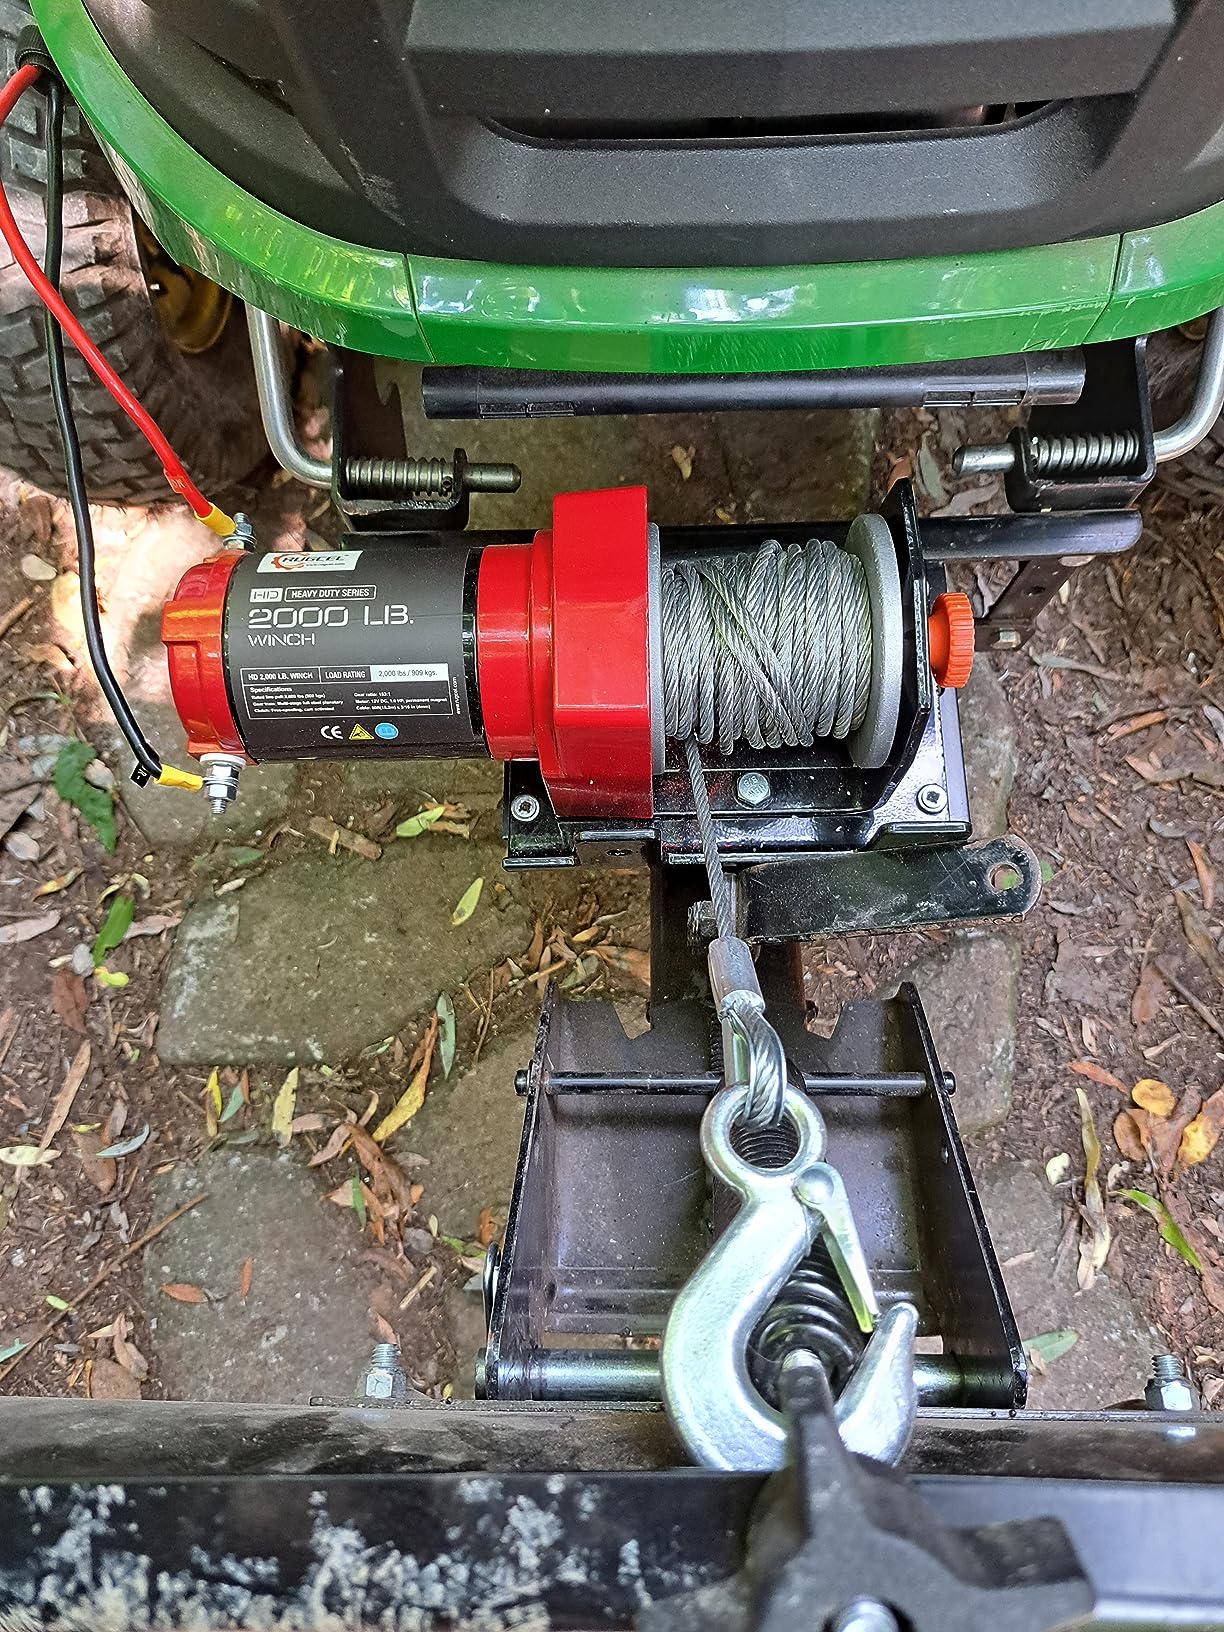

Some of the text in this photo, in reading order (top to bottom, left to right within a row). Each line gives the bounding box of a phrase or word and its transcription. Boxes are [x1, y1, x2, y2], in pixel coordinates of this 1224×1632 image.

[253, 588, 370, 600] HD HEAVY DUTY SERIES
[248, 604, 414, 629] 2000 LB.
[247, 633, 316, 647] WINCH
[247, 673, 259, 681] HD
[260, 673, 277, 681] 2,000
[289, 672, 314, 680] WINCH
[324, 669, 366, 679] LOAD RATING
[378, 670, 396, 678] 2,000
[424, 668, 438, 677] kgs.
[249, 686, 293, 694] Specifications
